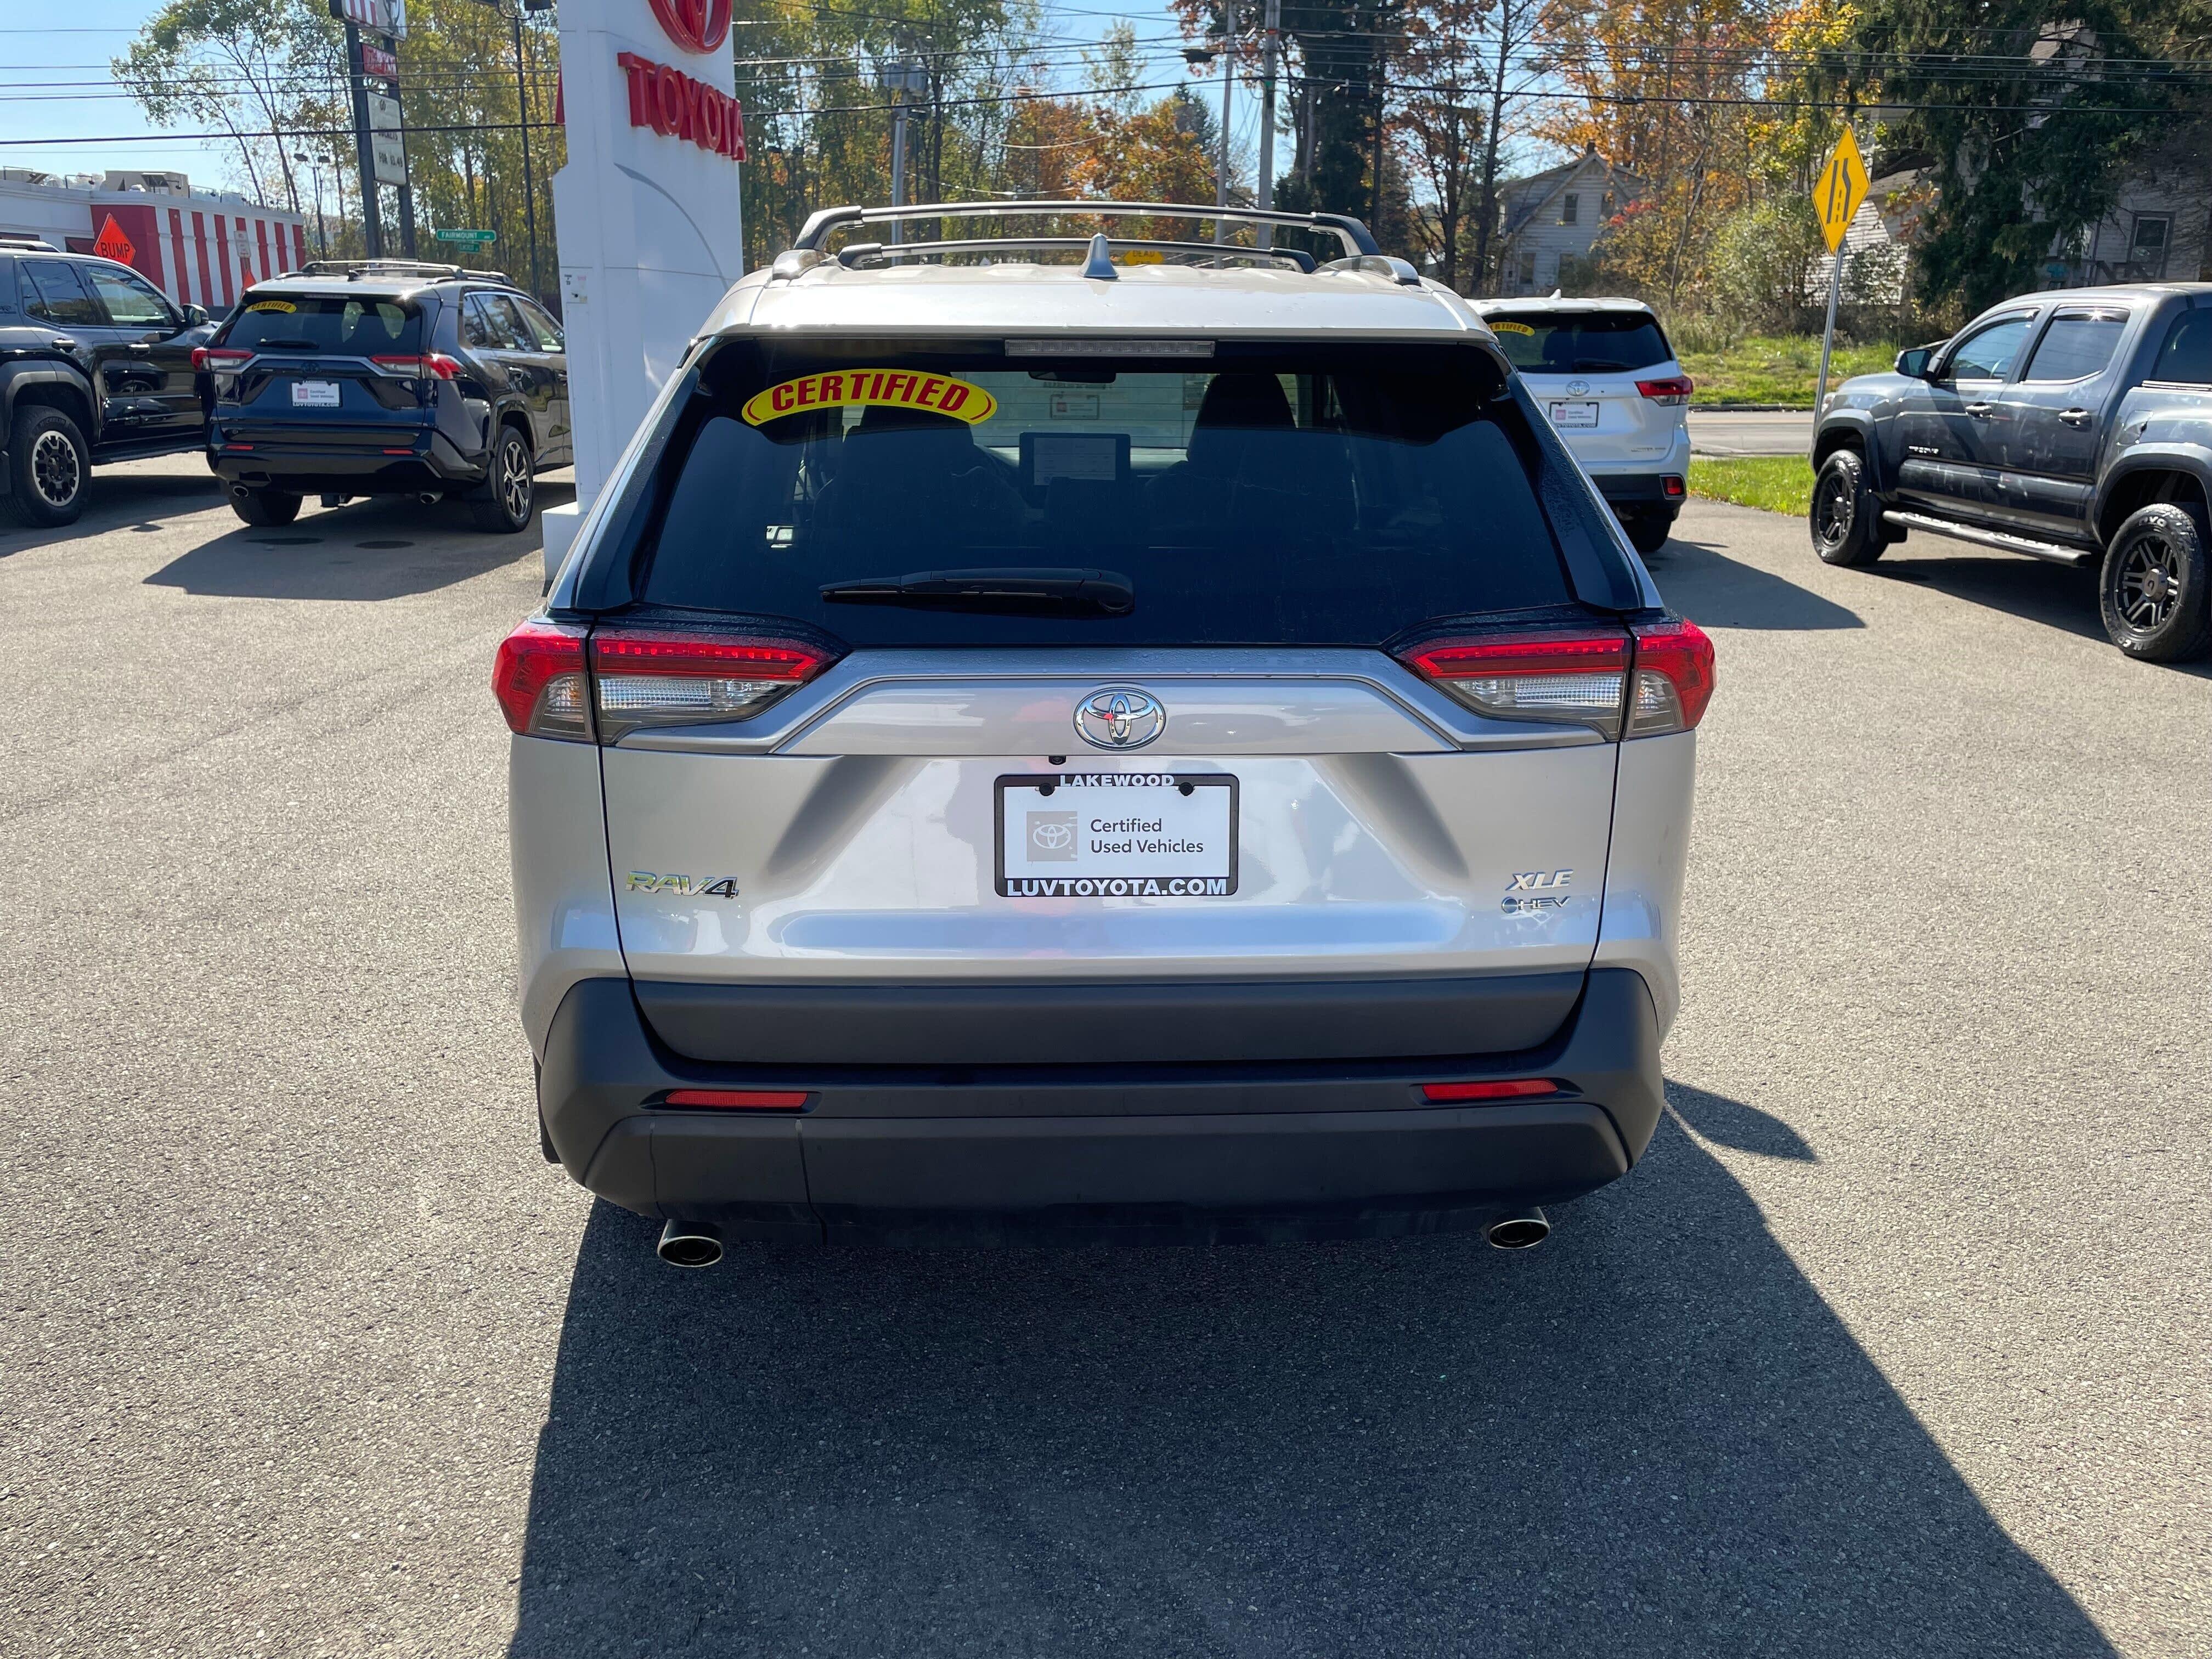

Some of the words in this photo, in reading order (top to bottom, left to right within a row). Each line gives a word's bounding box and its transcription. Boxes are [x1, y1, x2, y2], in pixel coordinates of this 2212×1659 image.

[617, 52, 747, 162] TOYOTA
[100, 242, 129, 258] BUMP
[772, 373, 970, 411] CERTIFIED
[1060, 775, 1175, 787] LAKEWOOD
[1090, 818, 1163, 832] Certified
[1091, 839, 1132, 853] Used
[1137, 839, 1204, 853] Vehicles
[624, 871, 739, 900] RAV4
[1007, 879, 1227, 896] LUVTOYOTA.COM
[1505, 868, 1574, 891] XLE
